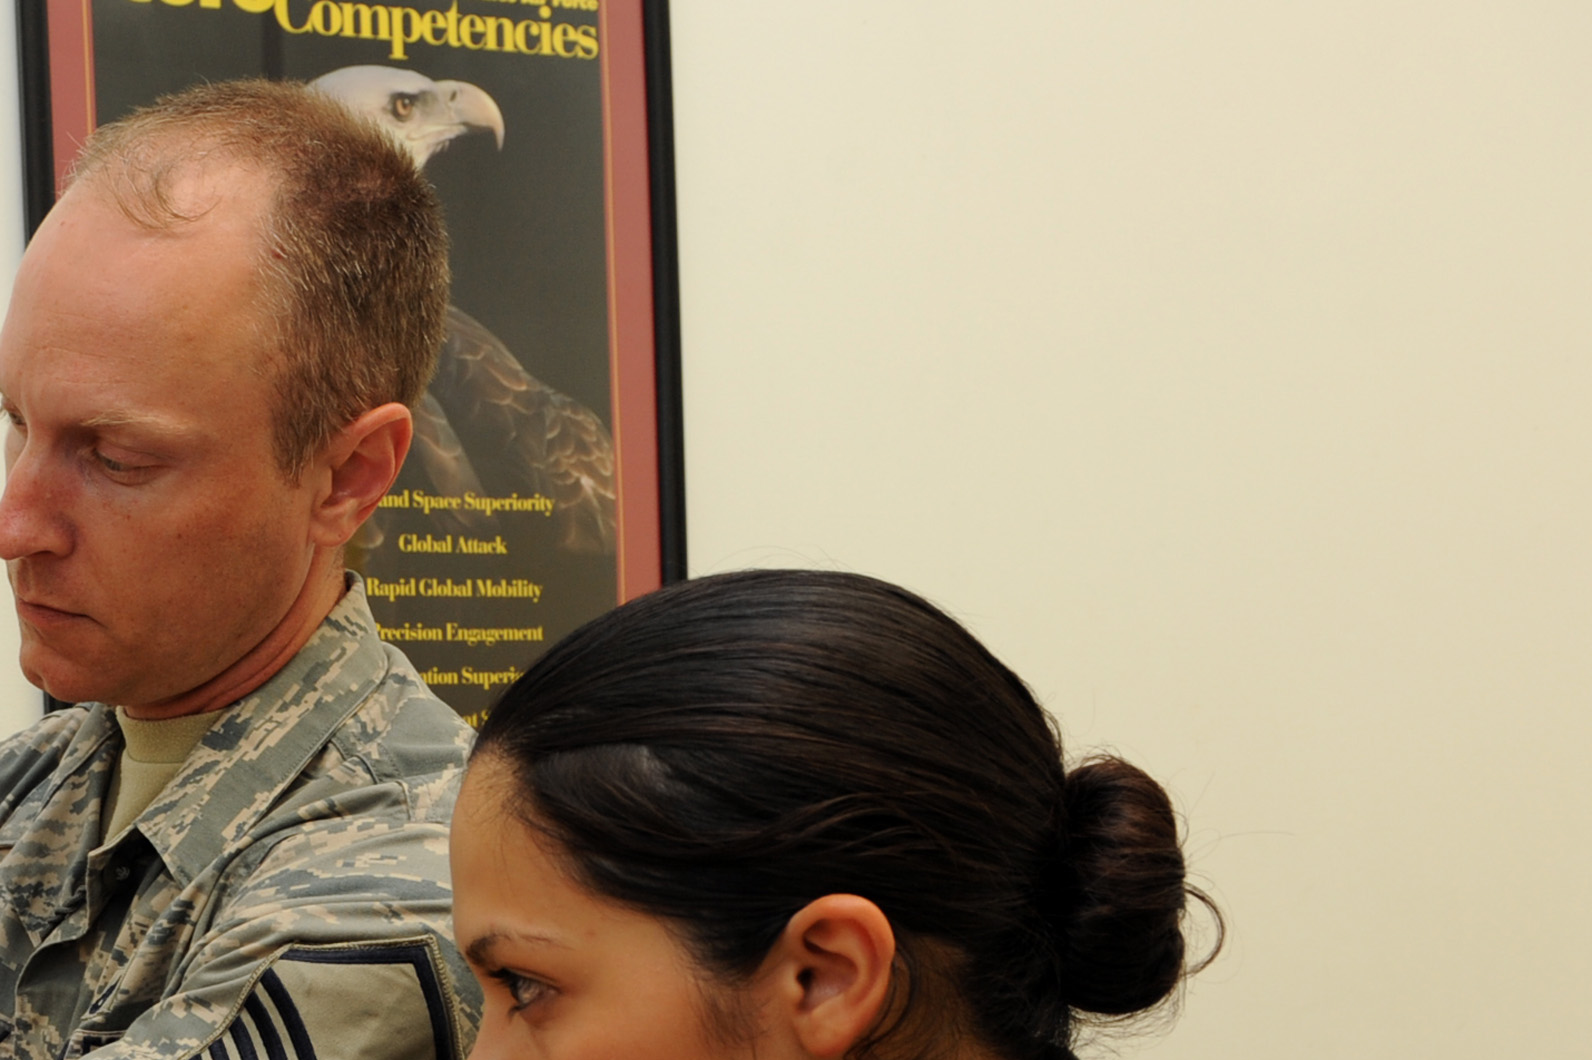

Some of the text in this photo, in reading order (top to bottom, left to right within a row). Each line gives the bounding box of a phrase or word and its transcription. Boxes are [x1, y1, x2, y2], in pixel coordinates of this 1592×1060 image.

[274, 0, 599, 59] Competencies
[412, 490, 461, 515] Space
[463, 491, 553, 517] Superiority
[398, 533, 507, 554] Global Attack
[366, 577, 543, 603] Rapid Global Mobility
[446, 622, 544, 646] Engagement
